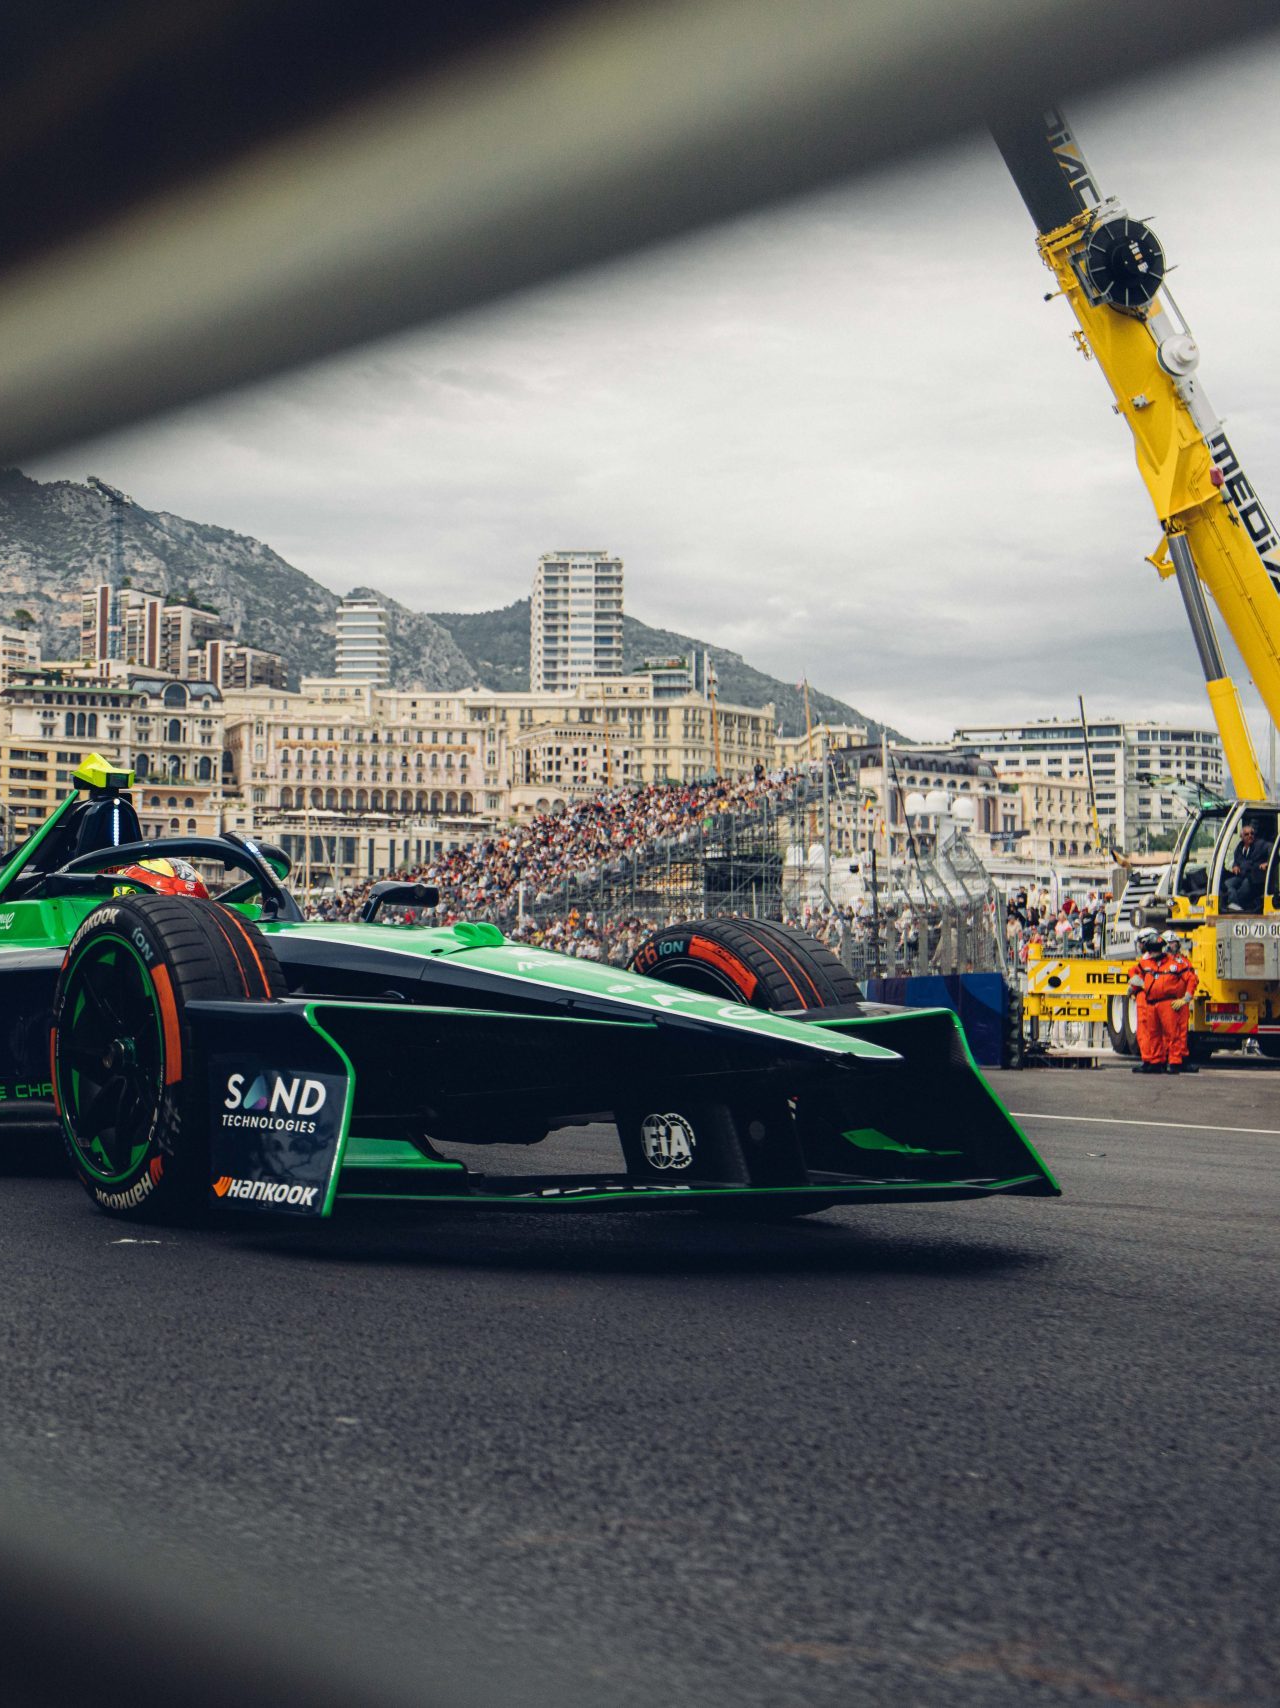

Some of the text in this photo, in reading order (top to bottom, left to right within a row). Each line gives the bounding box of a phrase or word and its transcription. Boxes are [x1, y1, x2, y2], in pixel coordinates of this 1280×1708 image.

[1235, 924, 1248, 937] 60
[1252, 924, 1265, 937] 70
[222, 1114, 317, 1134] TECHNOLOGIES
